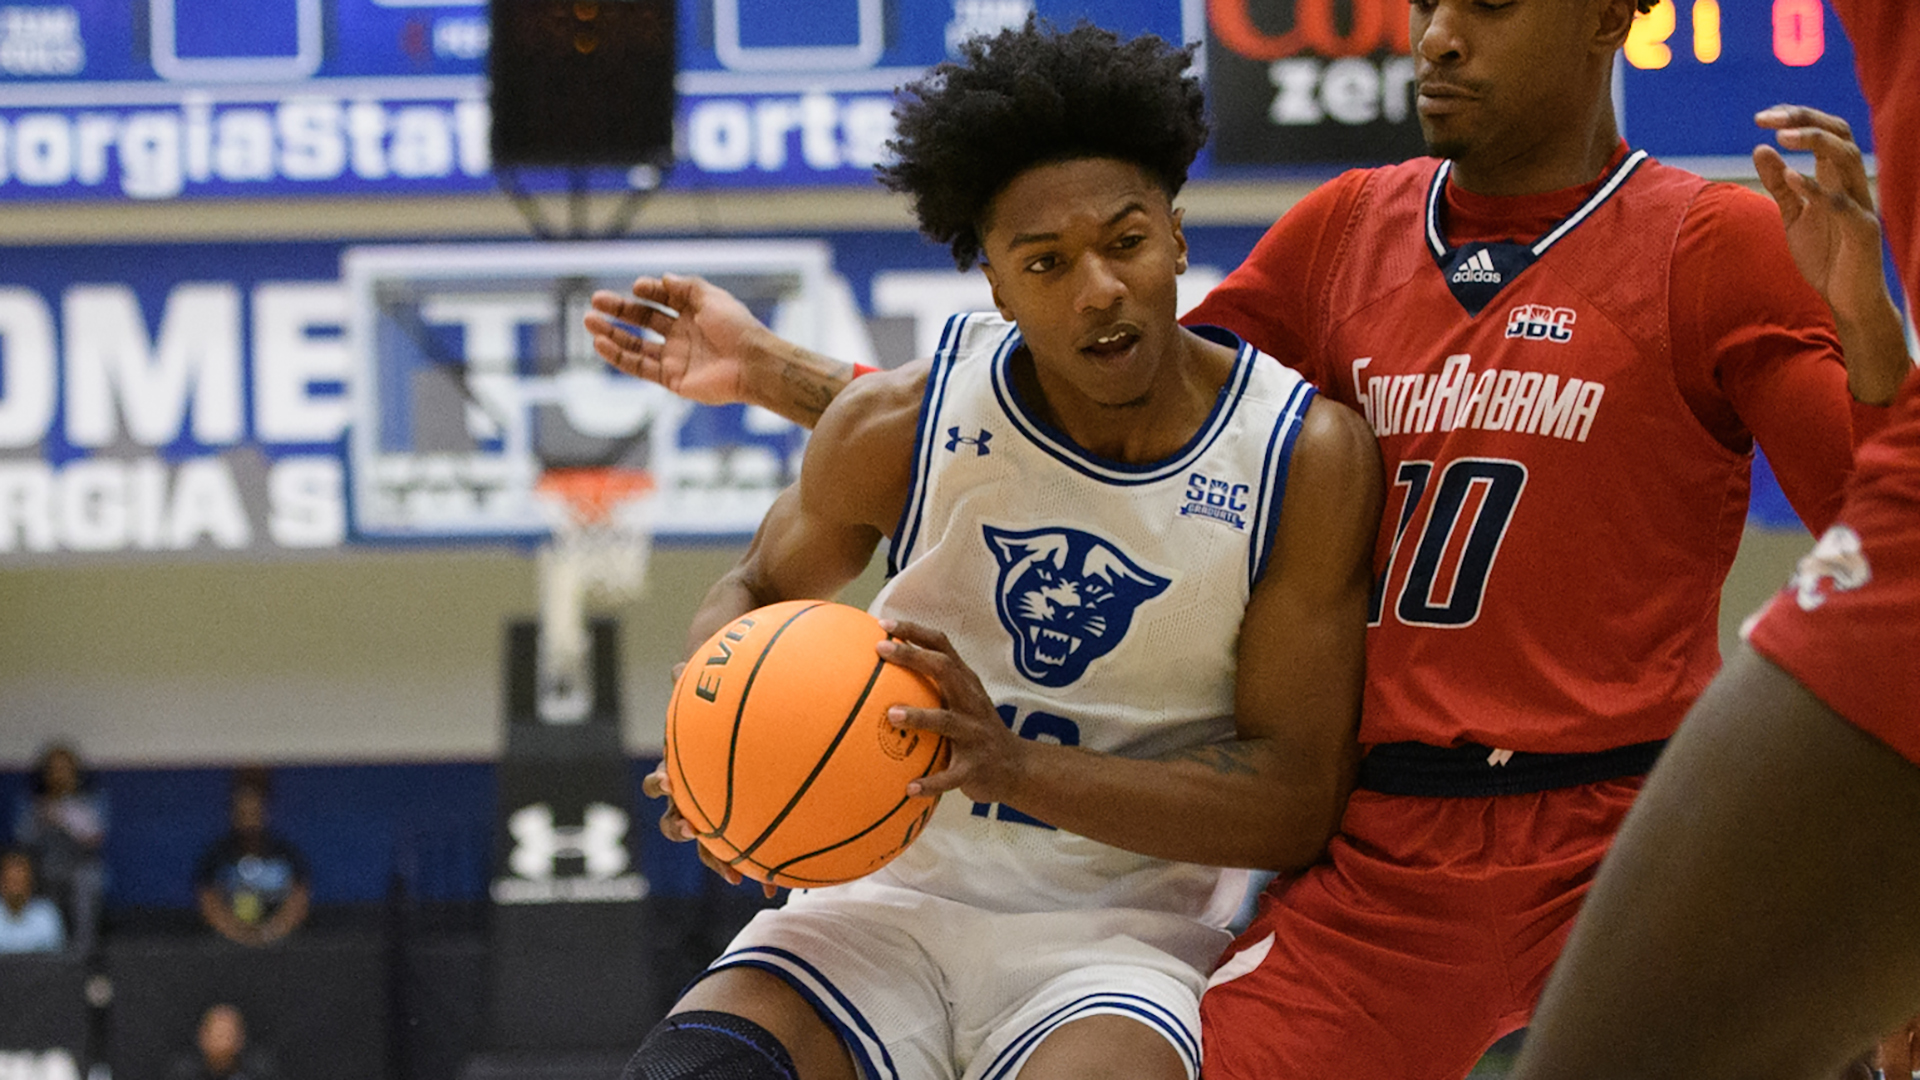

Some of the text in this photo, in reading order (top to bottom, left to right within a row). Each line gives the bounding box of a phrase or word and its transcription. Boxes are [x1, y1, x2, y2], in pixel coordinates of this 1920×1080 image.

[1268, 56, 1415, 124] zer
[1452, 268, 1501, 284] adidas
[1505, 303, 1577, 344] SBC
[1185, 472, 1250, 512] SBC
[1366, 456, 1529, 630] 10
[695, 616, 757, 704] EVO
